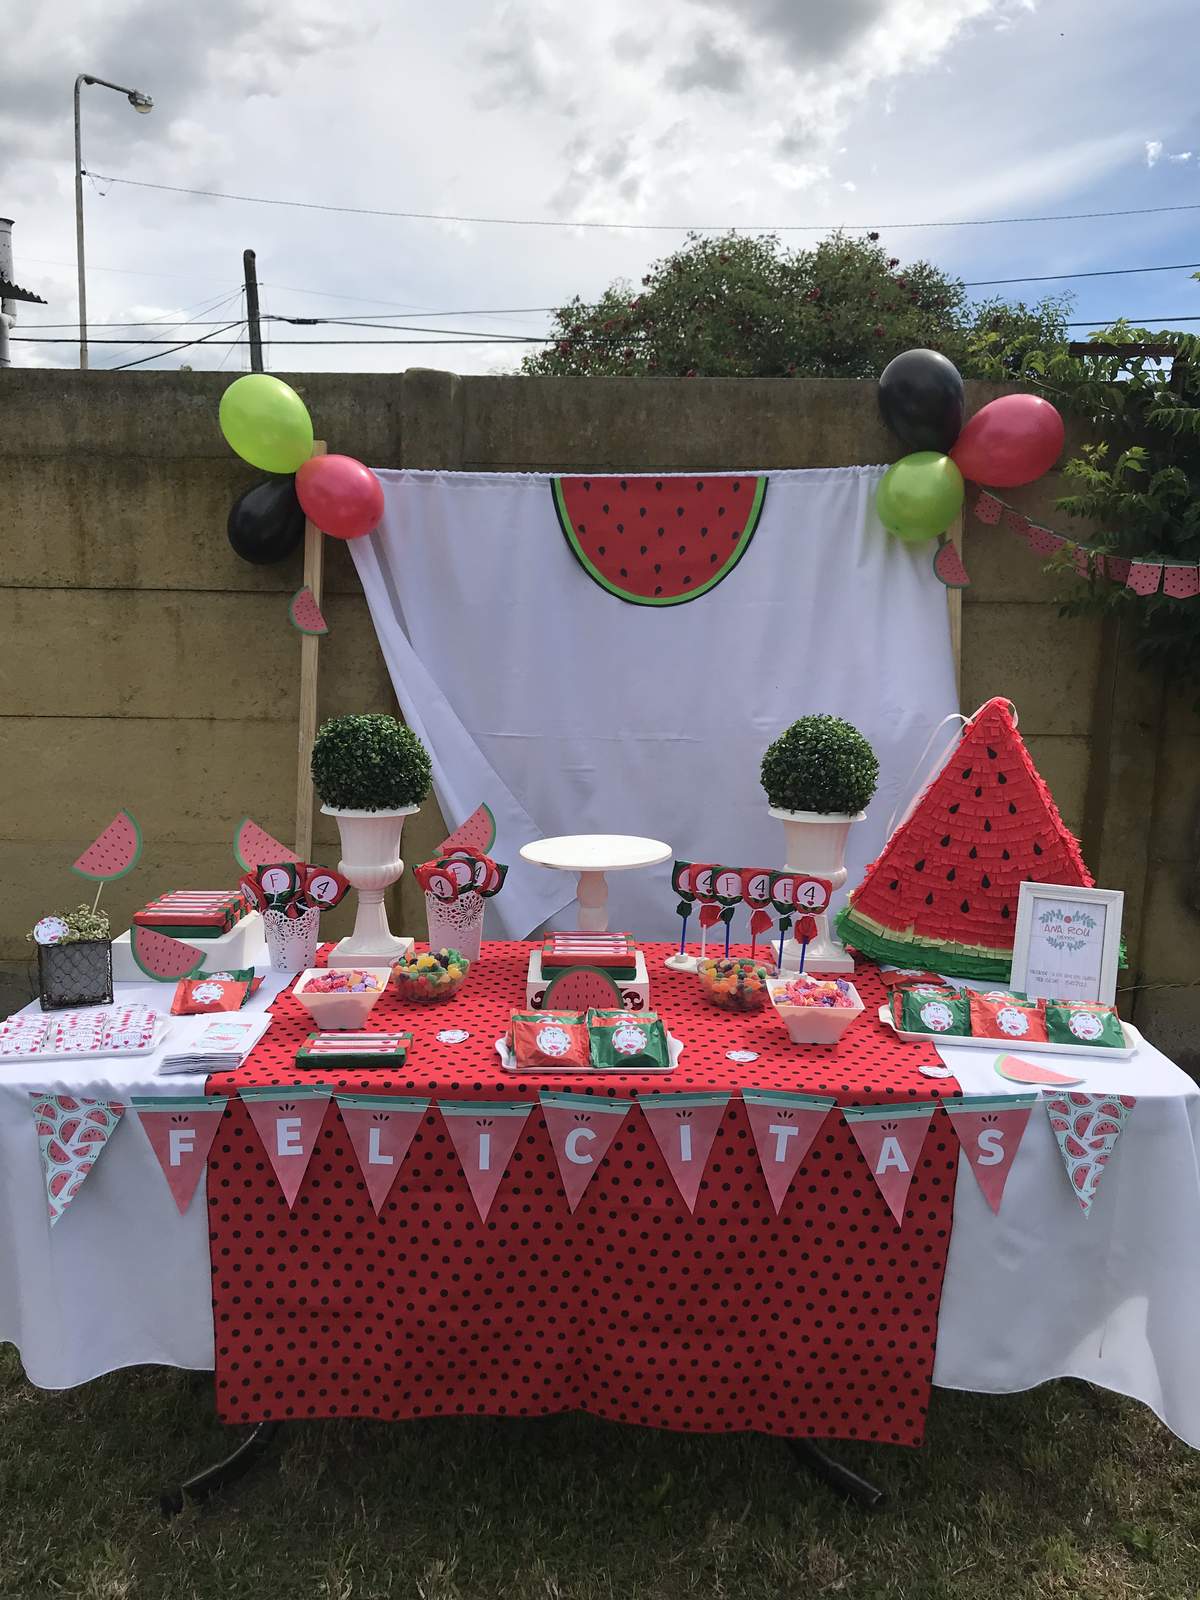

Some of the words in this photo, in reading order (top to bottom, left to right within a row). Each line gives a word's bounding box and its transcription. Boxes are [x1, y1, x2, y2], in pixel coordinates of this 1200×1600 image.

[270, 873, 280, 888] F
[435, 880, 444, 892] 4
[725, 878, 735, 891] F
[755, 880, 765, 893] 4
[317, 881, 330, 894] 4
[783, 884, 792, 897] F
[804, 886, 815, 900] 4
[1044, 924, 1063, 934] ANA
[1067, 926, 1090, 937] ROU
